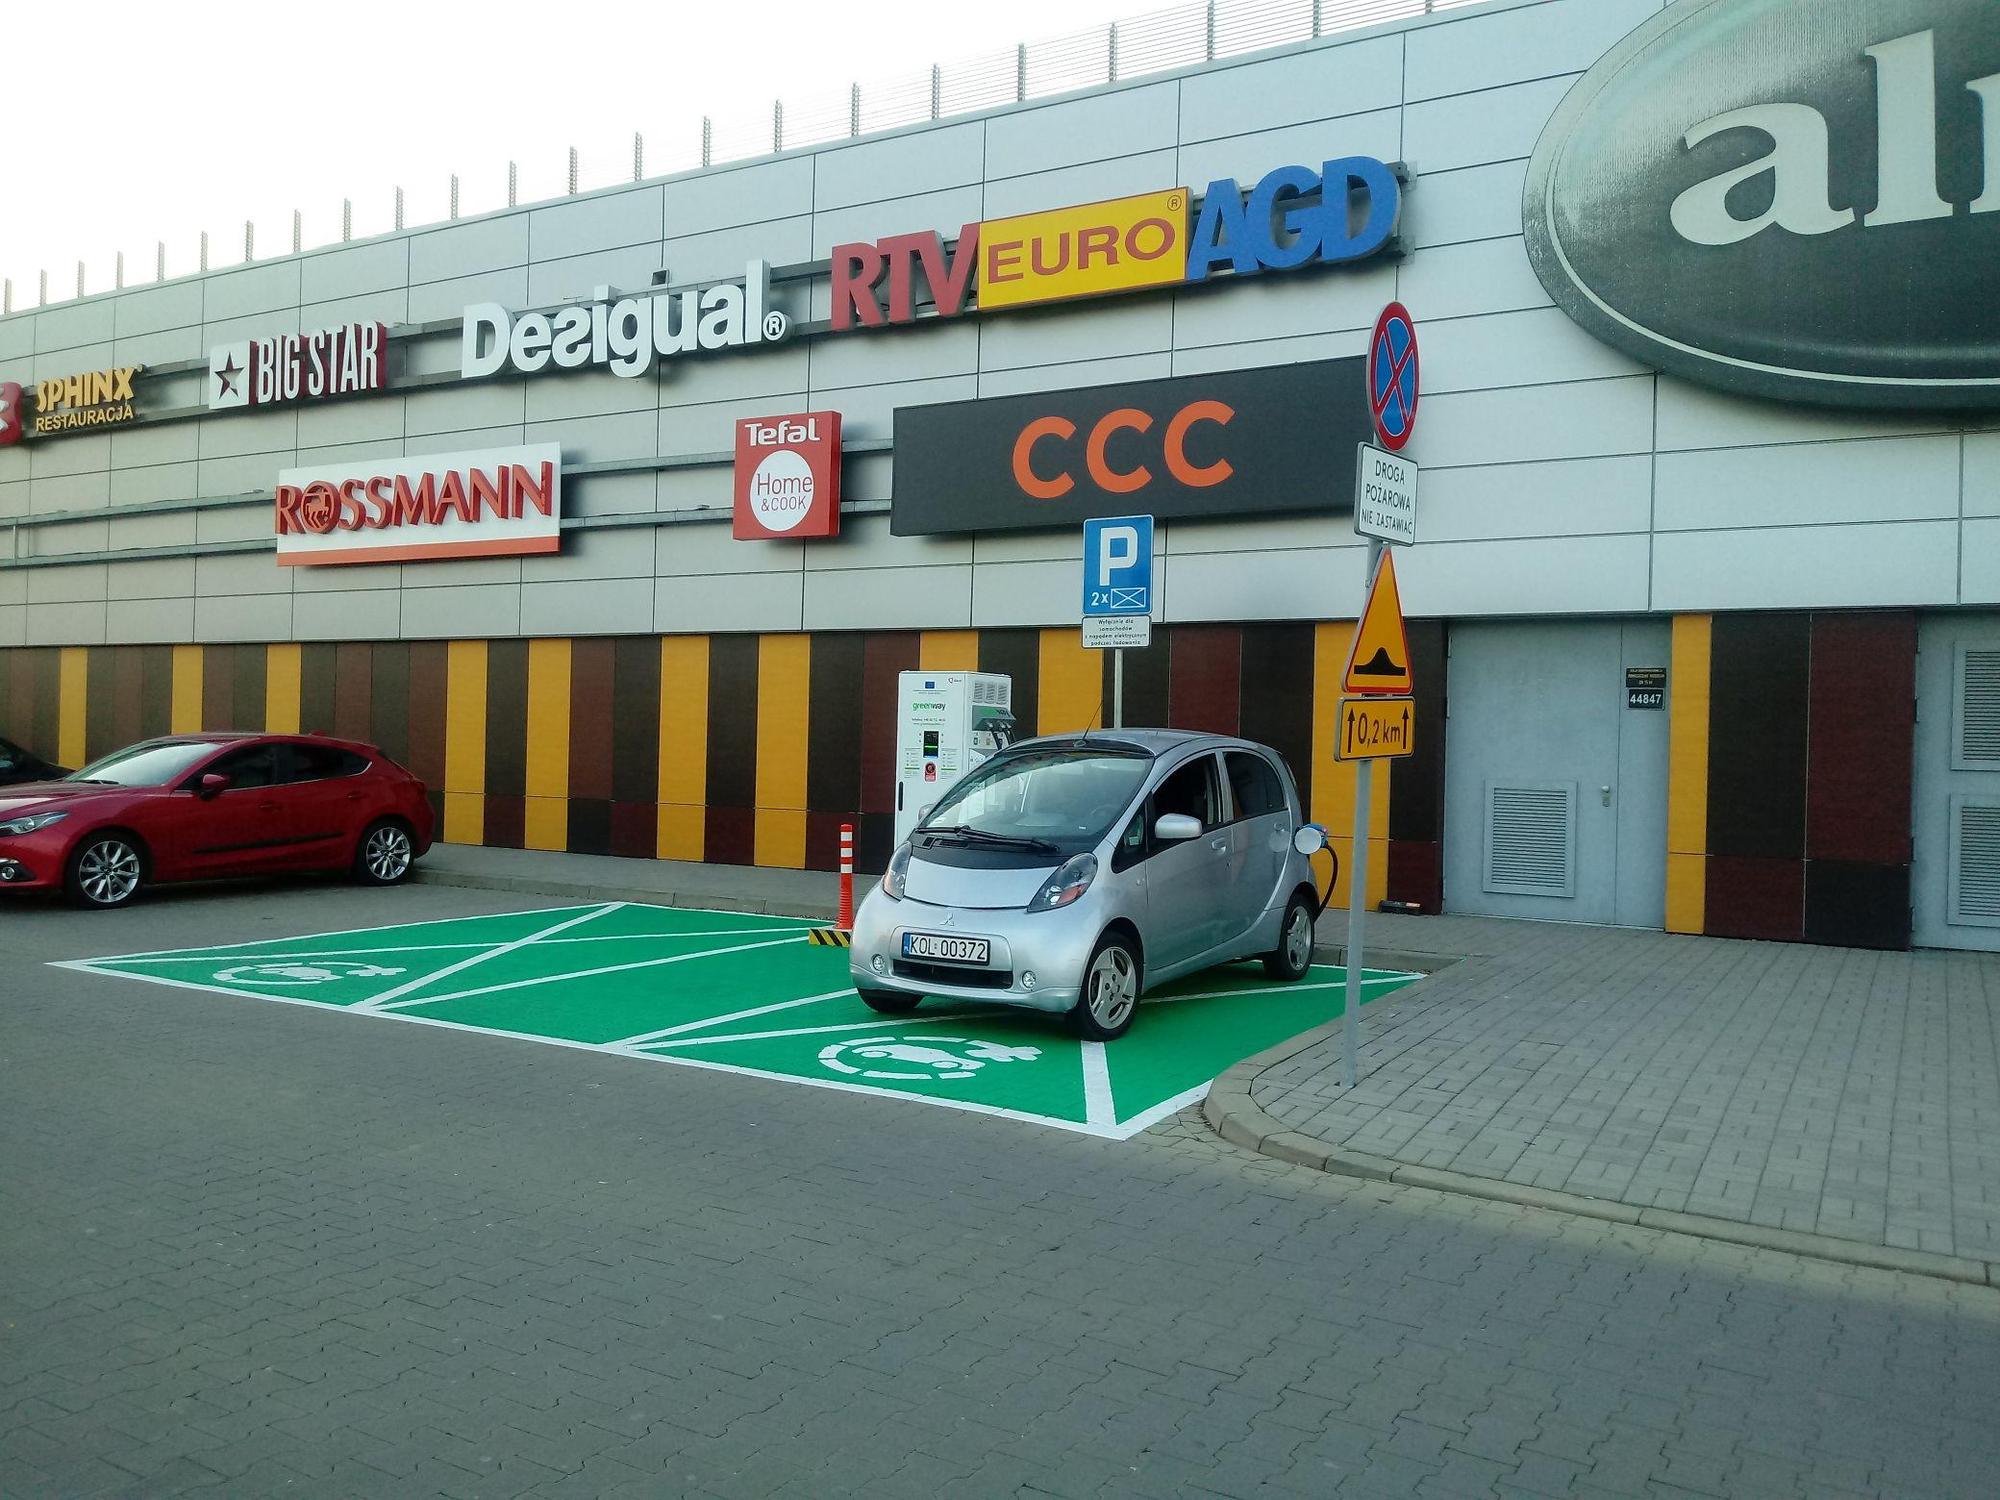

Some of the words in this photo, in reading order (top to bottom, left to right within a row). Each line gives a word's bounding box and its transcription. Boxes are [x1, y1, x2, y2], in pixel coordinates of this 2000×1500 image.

[1670, 28, 2000, 246] al
[830, 223, 980, 331] RTV
[987, 218, 1176, 284] EURO
[1186, 155, 1400, 281] AGD
[257, 334, 301, 404] BIG
[308, 320, 384, 396] STAR
[37, 368, 135, 413] SPHINX
[37, 405, 134, 432] RESTAURACJA
[745, 418, 820, 446] Tefal
[1012, 400, 1236, 499] CCC
[757, 473, 812, 495] Home
[1375, 460, 1405, 485] DROGA
[275, 461, 553, 535] ROSSMANN
[1366, 482, 1411, 511] POŻAROWA
[1362, 509, 1373, 524] NIE
[1377, 512, 1412, 534] ZASTAWIAĆ
[1100, 526, 1138, 586] P
[912, 702, 946, 711] greenway
[1630, 694, 1662, 704] 44847
[1358, 712, 1379, 748] 0,2
[1383, 719, 1401, 744] km
[910, 936, 935, 955] KOL
[940, 940, 986, 960] 00372
